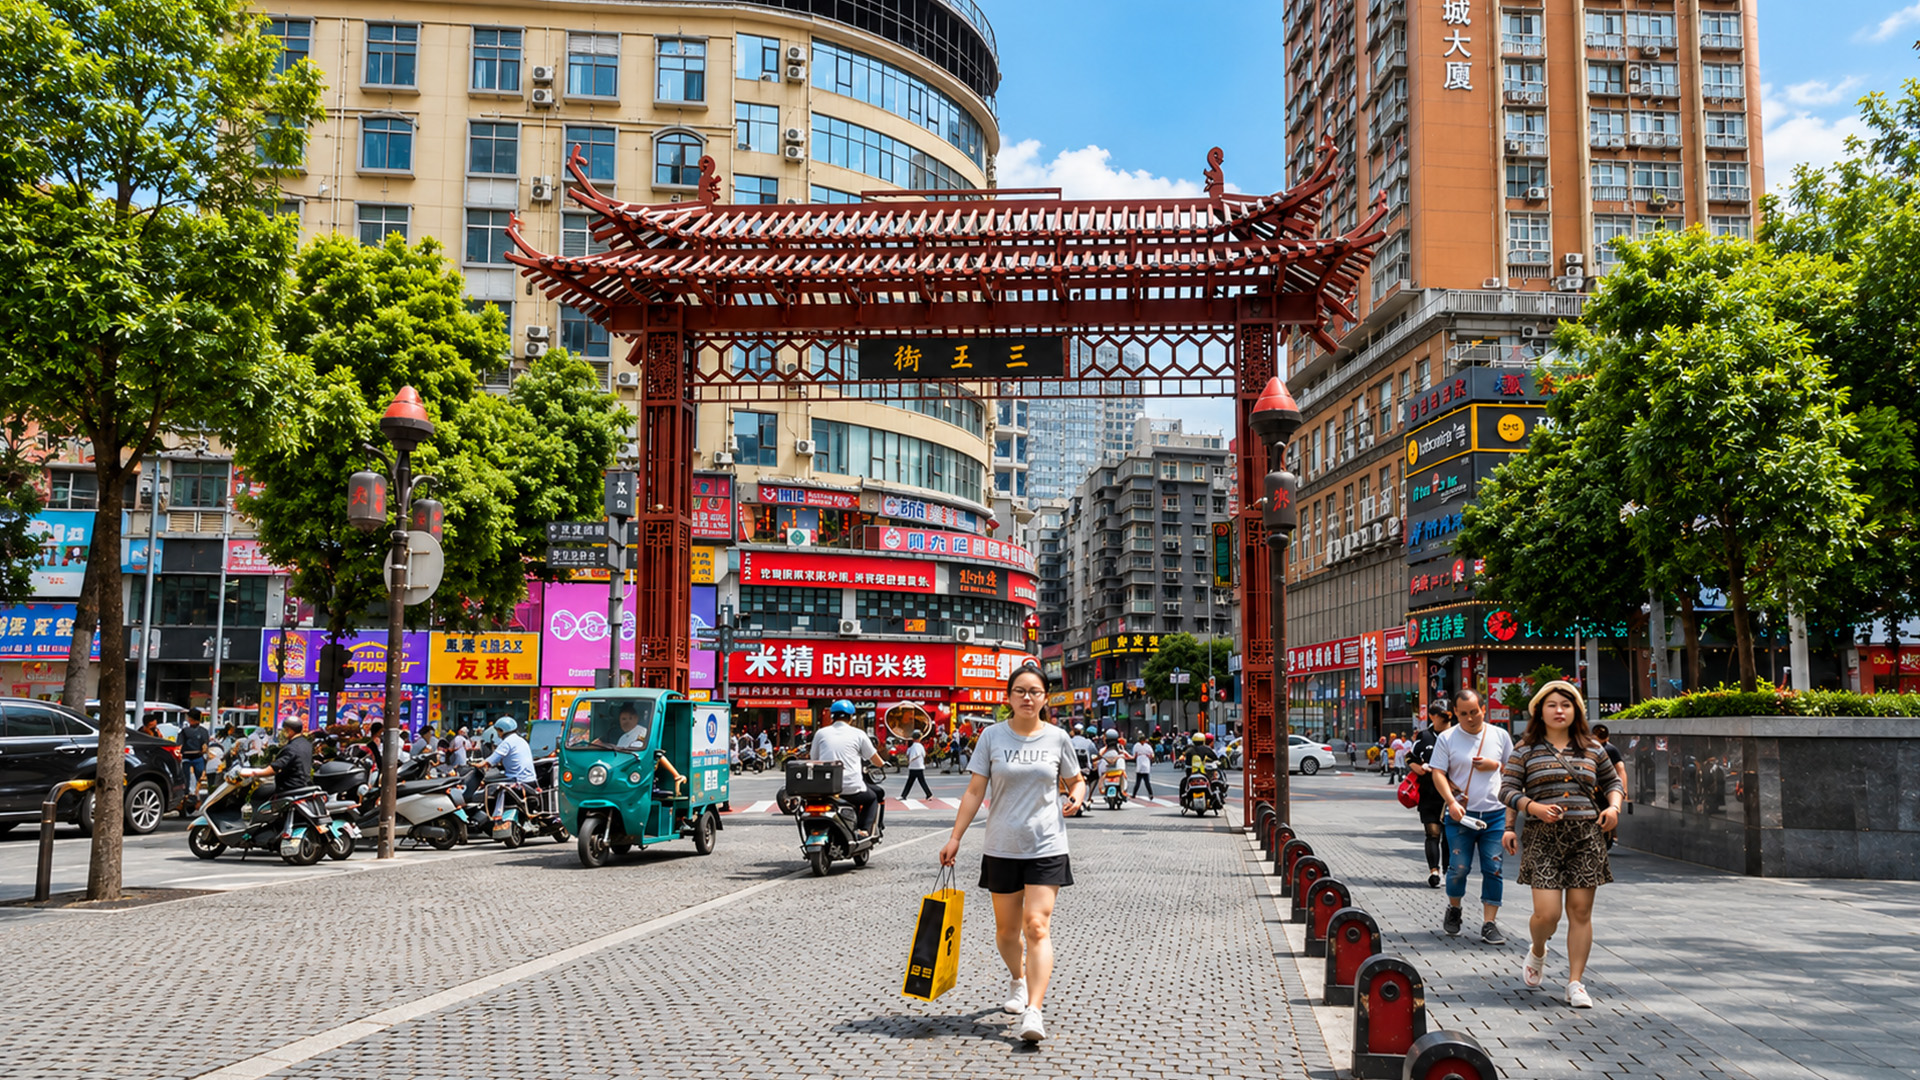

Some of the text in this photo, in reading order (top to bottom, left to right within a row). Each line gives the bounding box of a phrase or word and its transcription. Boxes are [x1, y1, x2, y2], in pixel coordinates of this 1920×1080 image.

[454, 656, 510, 680] 友琪
[822, 652, 927, 679] 时尚米线
[1004, 749, 1049, 763] VALUE
